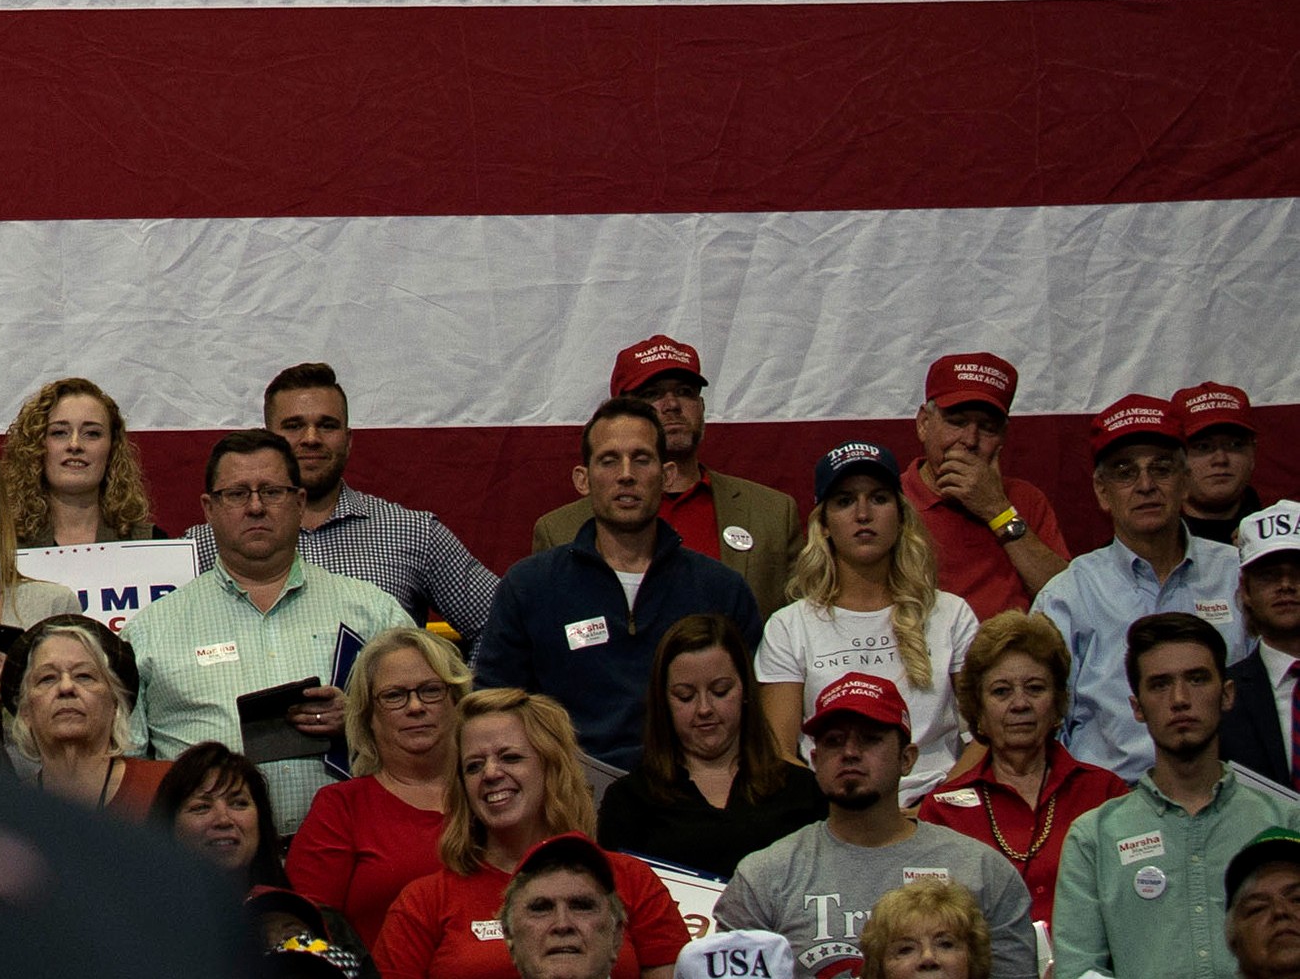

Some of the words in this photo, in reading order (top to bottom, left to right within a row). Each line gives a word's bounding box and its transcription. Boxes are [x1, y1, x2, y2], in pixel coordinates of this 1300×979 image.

[634, 345, 658, 359] MAKE
[640, 352, 667, 365] GREAT
[953, 363, 979, 372] MAKE
[957, 372, 985, 382] GREAT
[1103, 410, 1125, 427] MAKE
[1125, 407, 1165, 417] AMERICA
[1107, 416, 1134, 432] GREAT
[1134, 416, 1162, 425] AGAIN
[827, 443, 880, 461] Trump
[851, 636, 890, 648] GOD
[813, 655, 851, 669] ONE
[821, 684, 842, 702] MAKE
[842, 680, 883, 694] AMERICA
[822, 689, 849, 708] GREAT
[849, 688, 880, 700] AGAIN
[1119, 836, 1161, 853] Marsha
[703, 949, 772, 979] USA
